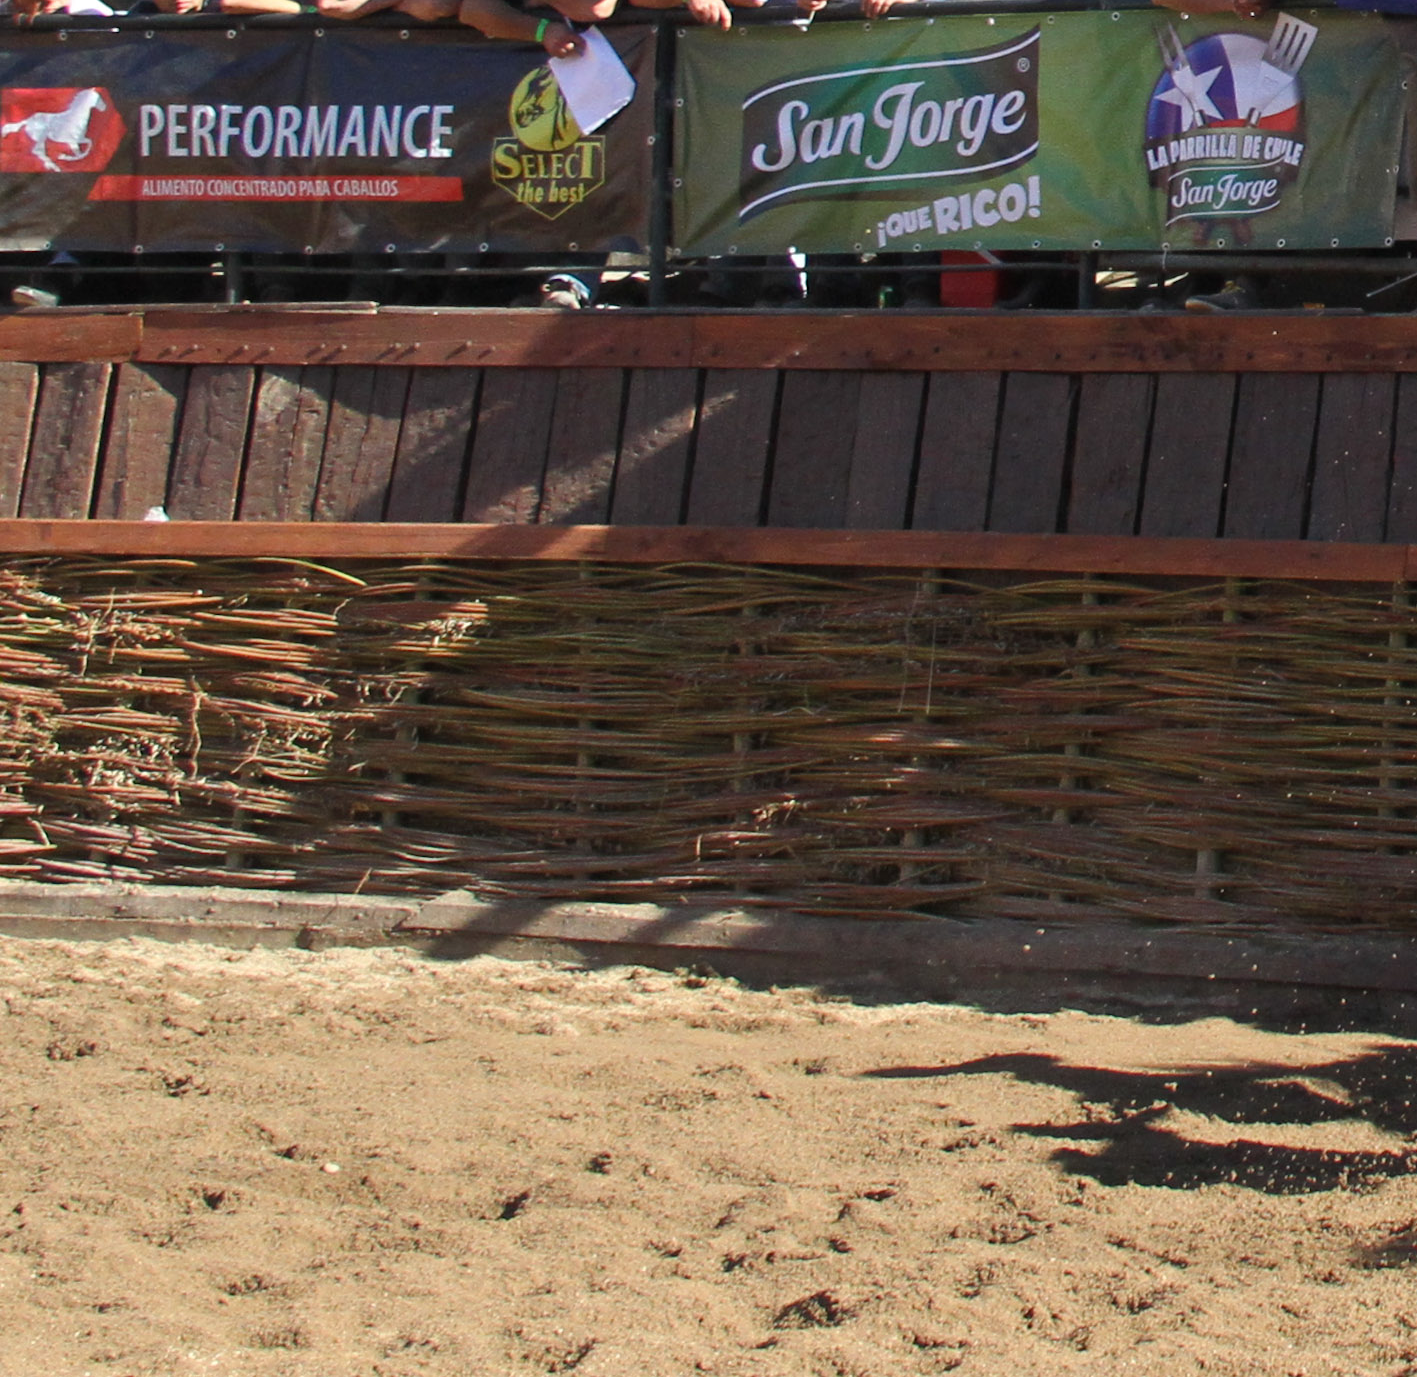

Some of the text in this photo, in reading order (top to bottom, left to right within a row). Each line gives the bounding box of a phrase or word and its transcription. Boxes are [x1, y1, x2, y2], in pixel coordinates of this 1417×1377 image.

[139, 103, 454, 158] PERFORMANCE
[752, 81, 1027, 172] San Jorge
[1147, 134, 1305, 171] LA PARRILLA DE CHILE
[142, 179, 399, 198] ALIMENTO CONCENTRADO PARA CABALLOS
[517, 180, 585, 203] the best
[1171, 174, 1278, 210] San Jorge
[878, 175, 1041, 248] ¡QUE RICO!
